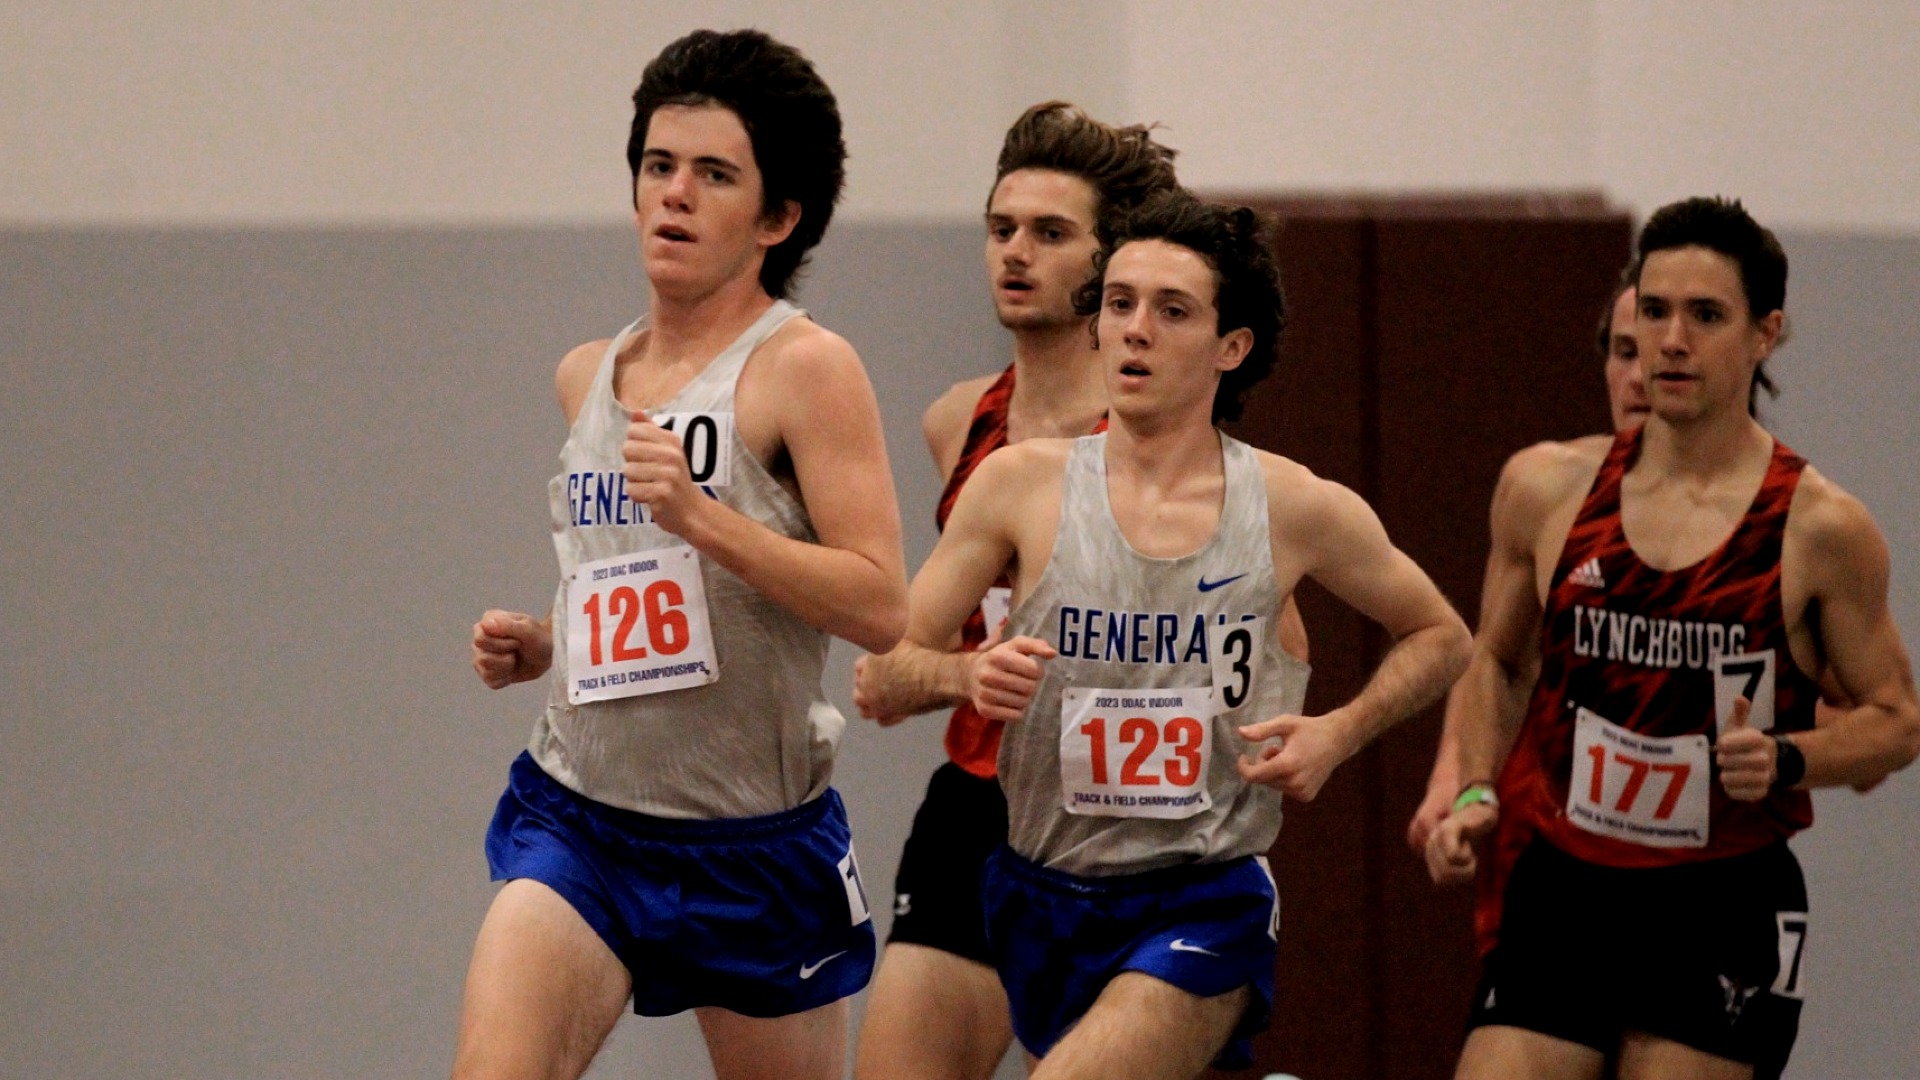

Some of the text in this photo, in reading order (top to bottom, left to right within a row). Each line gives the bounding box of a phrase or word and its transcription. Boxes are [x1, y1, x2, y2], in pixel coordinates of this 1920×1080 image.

[660, 415, 718, 483] 0
[629, 559, 659, 575] INDOOR
[583, 579, 690, 666] 126
[1058, 606, 1257, 664] GENERA
[577, 678, 600, 691] TRACK
[607, 672, 627, 687] FIELD
[1222, 628, 1252, 709] 3
[1721, 660, 1765, 704] 7
[1095, 696, 1183, 709] 2023 ODAC INDOOR
[1080, 716, 1204, 787] 123
[1587, 742, 1692, 821] 177
[1074, 792, 1101, 805] TRACK
[1103, 794, 1112, 805] &
[1113, 794, 1137, 806] FIELD
[1782, 920, 1807, 992] 7
